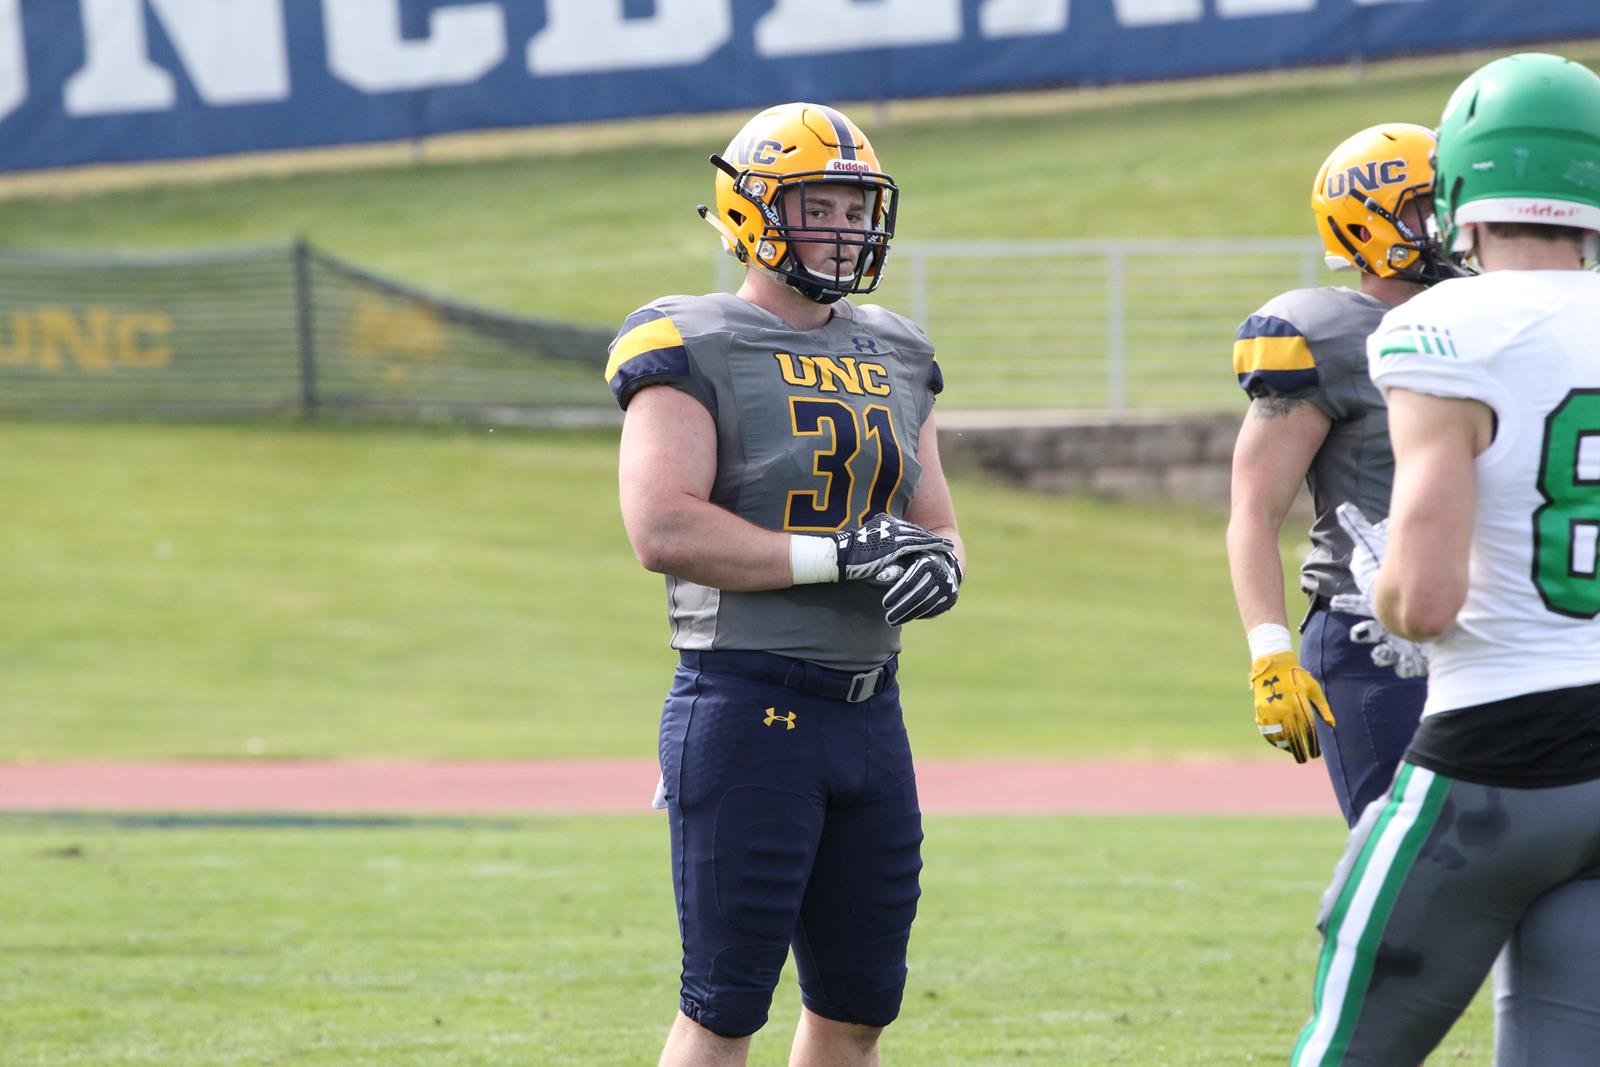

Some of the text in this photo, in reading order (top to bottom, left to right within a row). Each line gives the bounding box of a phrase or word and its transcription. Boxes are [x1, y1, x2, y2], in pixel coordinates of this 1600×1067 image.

[833, 161, 870, 173] Riddell
[1326, 158, 1407, 199] UNC
[1506, 203, 1584, 217] iddel
[774, 352, 892, 397] UNC
[783, 396, 904, 533] 31
[1531, 388, 1600, 620] 8
